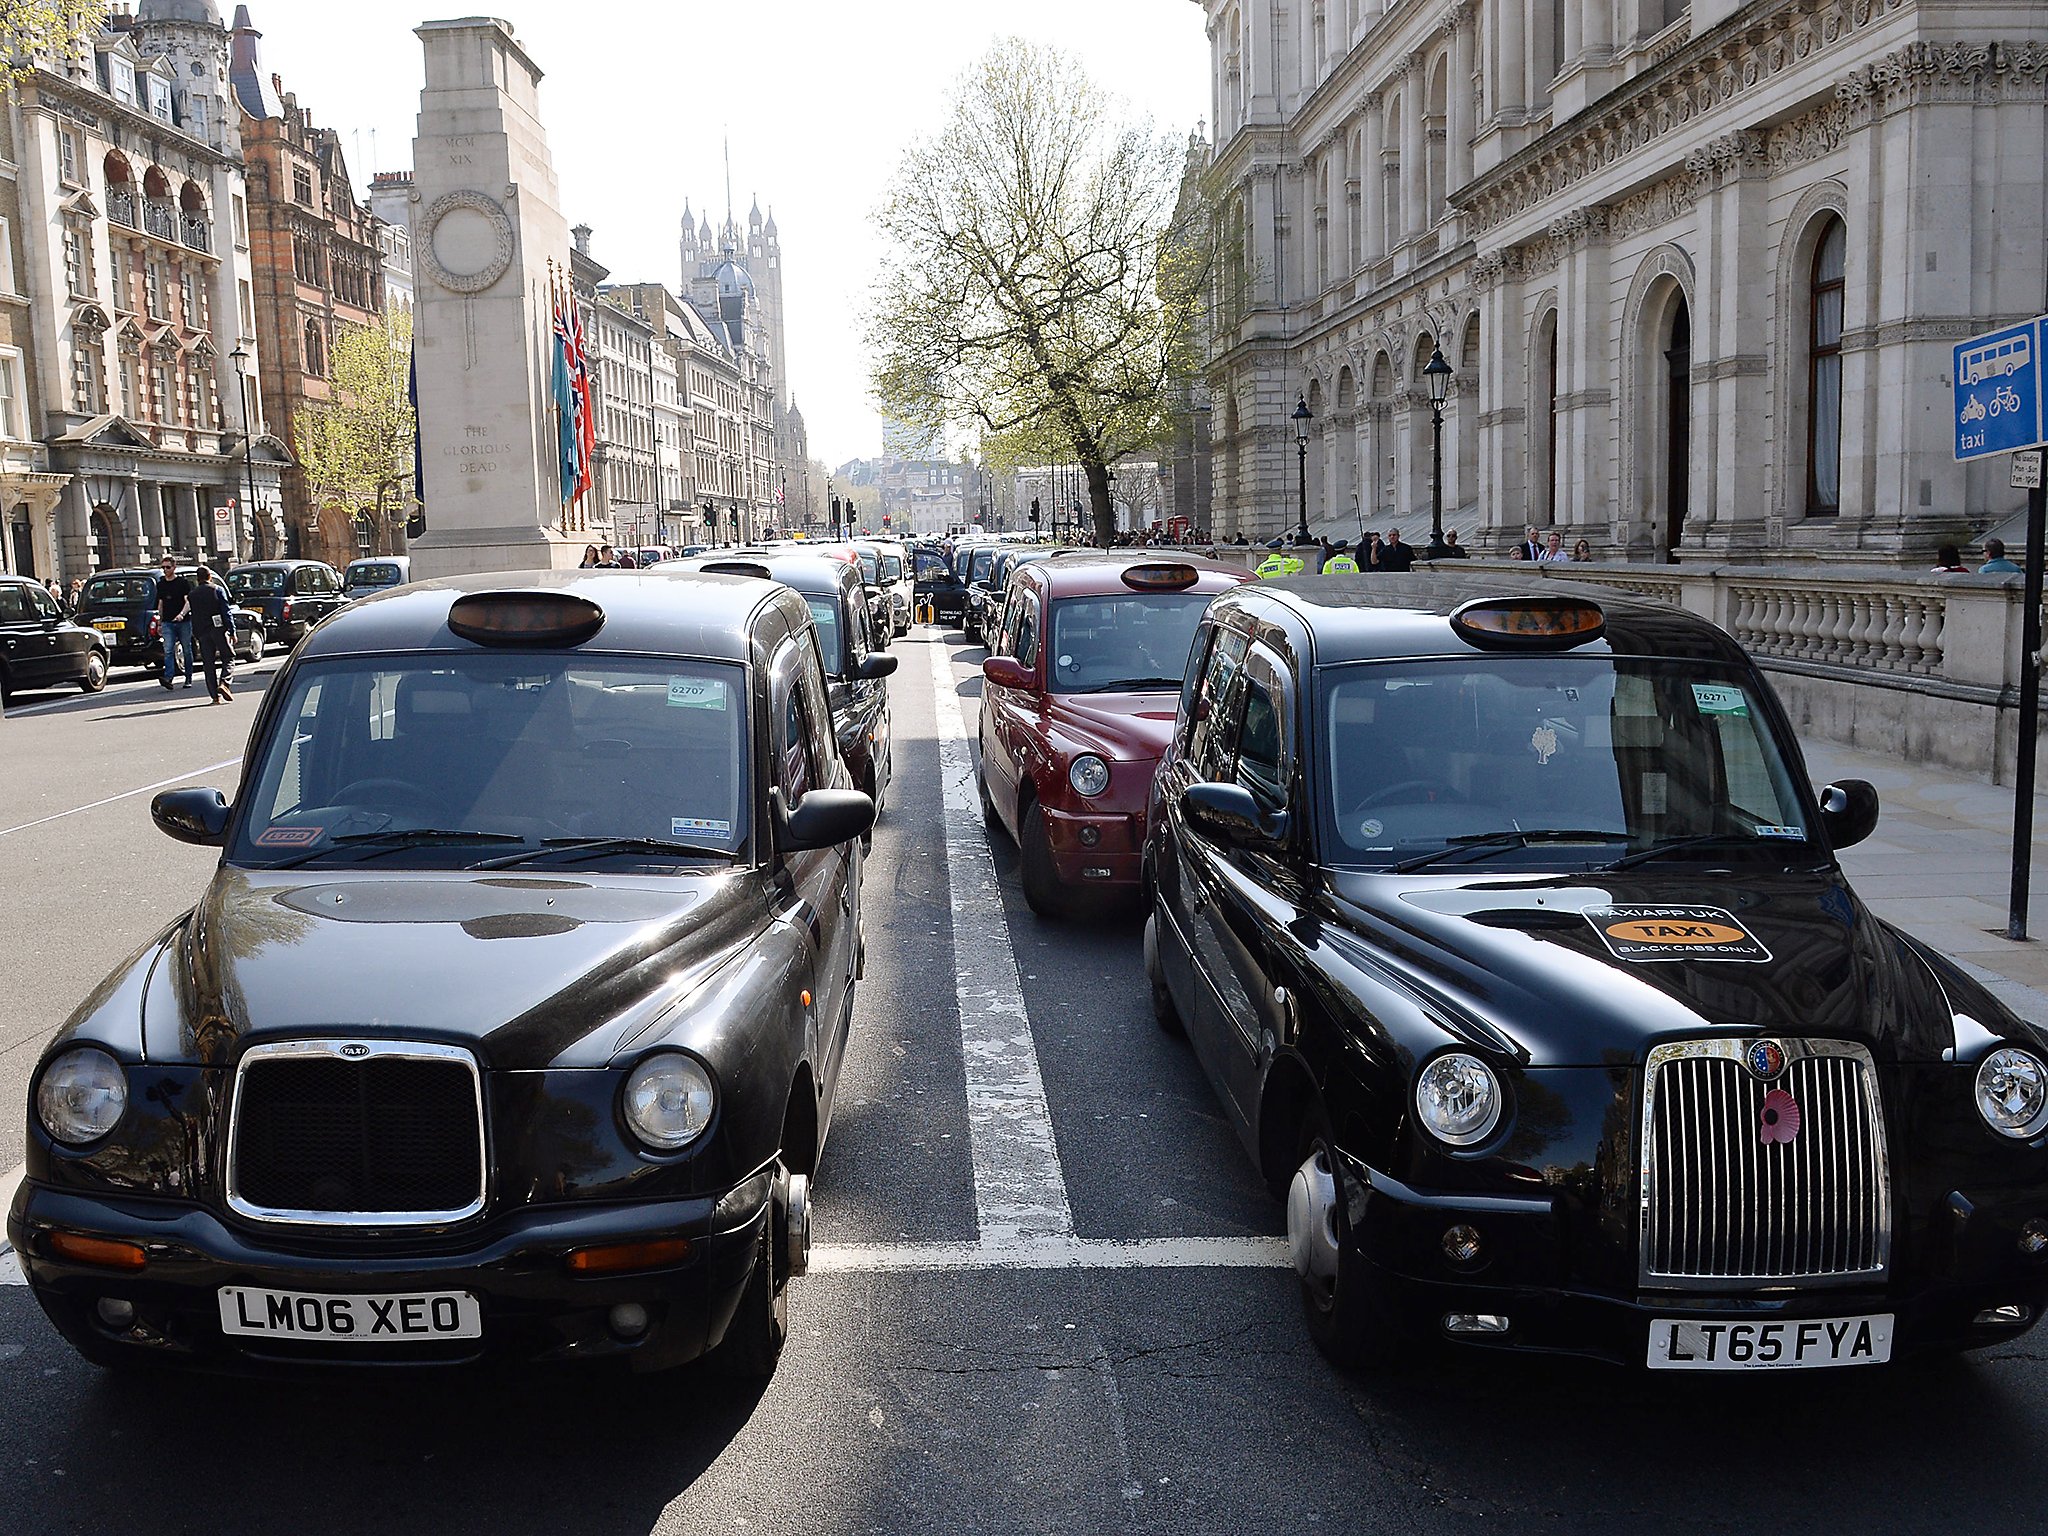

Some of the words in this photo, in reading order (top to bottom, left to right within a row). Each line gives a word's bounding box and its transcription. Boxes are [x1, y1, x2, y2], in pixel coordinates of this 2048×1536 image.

[449, 154, 472, 165] XIX
[463, 424, 489, 438] THE
[1960, 428, 1985, 450] taxi
[442, 443, 512, 456] GLORIOUS
[459, 461, 497, 473] DEAD
[1496, 608, 1580, 632] TAXI
[671, 686, 705, 695] 62707
[1697, 692, 1727, 702] 76271
[1590, 908, 1687, 919] TAXIAPP
[1688, 909, 1725, 919] UK
[1633, 925, 1716, 938] TAXI
[1618, 944, 1673, 954] BLACK
[1673, 944, 1717, 953] CABS
[1717, 945, 1758, 955] ONLY
[344, 1047, 366, 1055] TAXI
[236, 1291, 356, 1333] LM06
[367, 1296, 461, 1334] XEO
[1668, 1324, 1785, 1362] LT65
[1794, 1319, 1874, 1361] FYA
